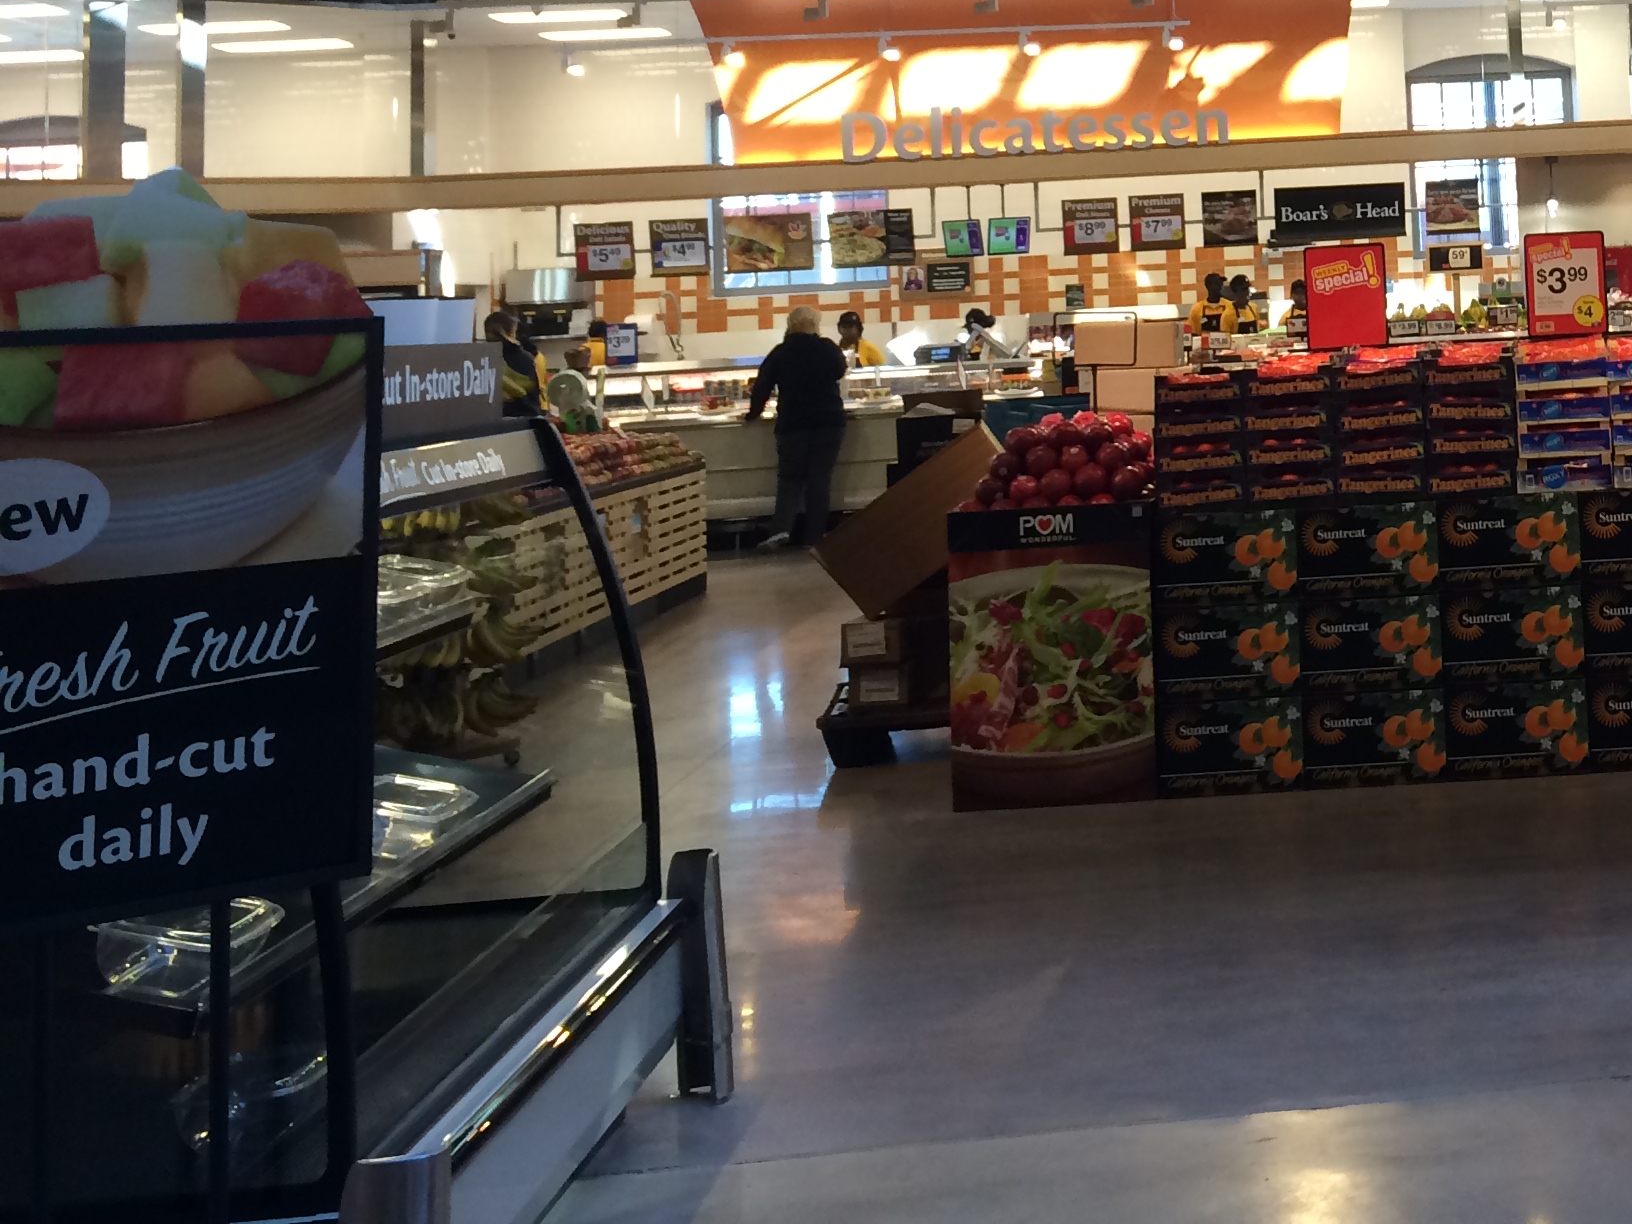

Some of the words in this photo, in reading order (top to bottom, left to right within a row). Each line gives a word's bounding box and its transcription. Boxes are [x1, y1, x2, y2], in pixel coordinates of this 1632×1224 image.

[841, 107, 1230, 163] Delicatessen
[1064, 201, 1115, 211] Premium
[1131, 196, 1182, 207] Premium
[1280, 204, 1329, 223] Boar's
[1355, 201, 1400, 219] Head
[576, 225, 629, 236] Delicious
[652, 222, 697, 232] Quality
[405, 364, 460, 402] In-store
[463, 357, 497, 404] Daily
[1337, 370, 1413, 389] Tangerines
[1426, 368, 1500, 384] Tangerines
[1430, 404, 1505, 419] Tangerines
[1341, 412, 1417, 429] Tangerines
[1433, 437, 1509, 453] Tangerines
[1342, 447, 1418, 464] Tangerines
[1430, 475, 1505, 492] Tangerines
[1542, 469, 1565, 484] ROXY
[1339, 477, 1416, 493] Tangerines
[0, 492, 90, 542] ew
[1456, 518, 1506, 531] Suntreat
[1316, 527, 1366, 540] Suntreat
[1175, 534, 1225, 549] Suntreat
[1461, 612, 1512, 626] Suntreat
[1178, 628, 1227, 642] Suntreat
[1319, 621, 1369, 635] Suntreat
[0, 621, 139, 714] resh
[156, 595, 320, 684] Fruit
[1465, 706, 1516, 720] Suntreat
[1323, 715, 1373, 729] Suntreat
[1179, 723, 1229, 737] Suntreat
[0, 726, 277, 806] hand-cut
[58, 803, 209, 872] daily
